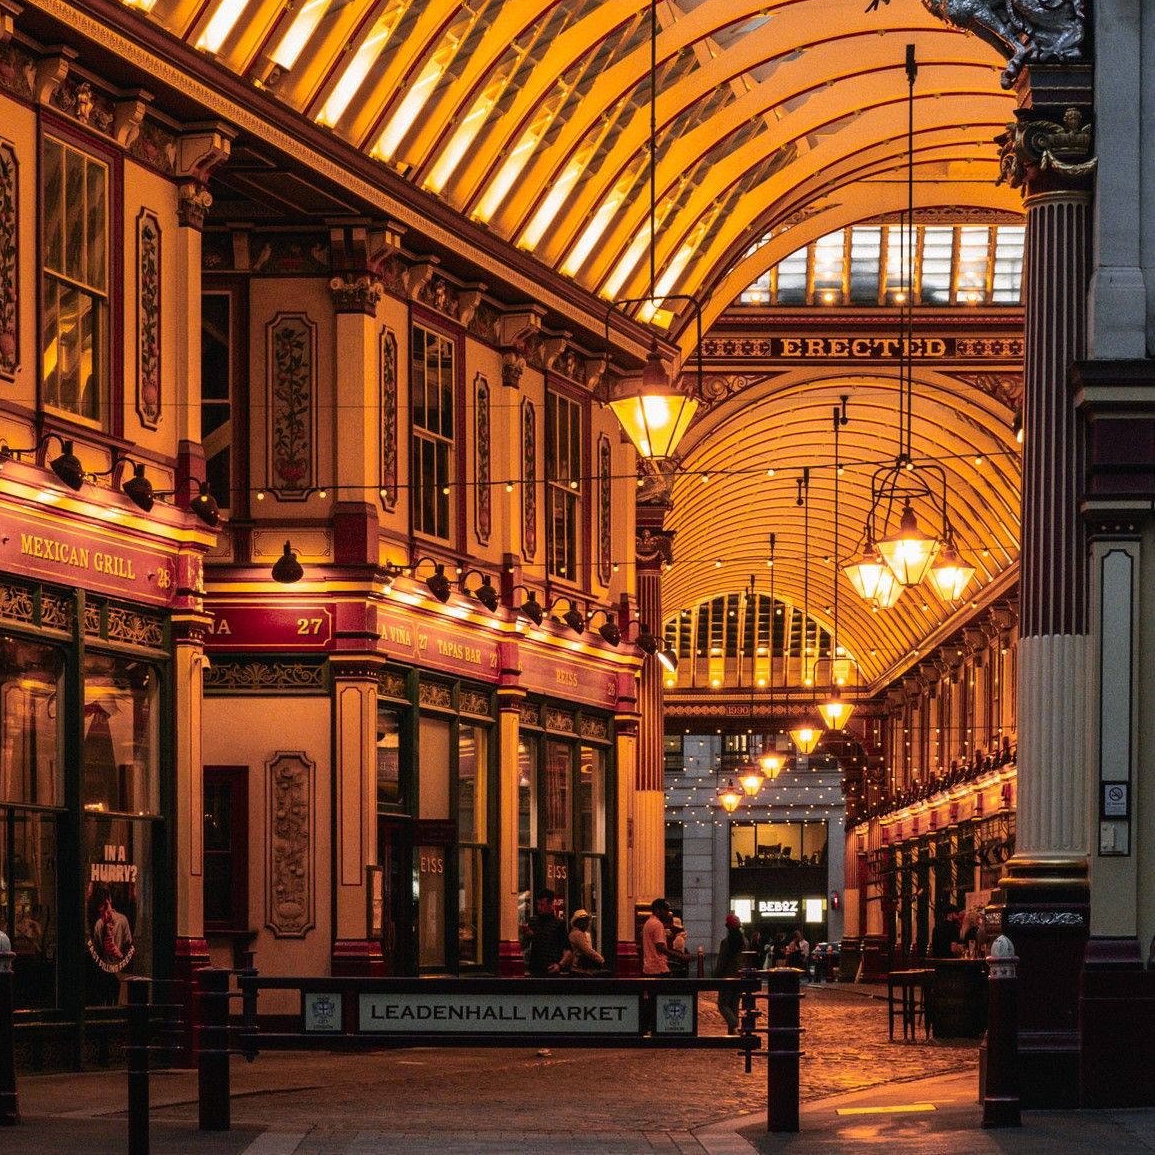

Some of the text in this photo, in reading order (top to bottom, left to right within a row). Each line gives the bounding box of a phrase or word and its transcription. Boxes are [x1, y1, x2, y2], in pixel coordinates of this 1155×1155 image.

[780, 338, 946, 357] ERECTED
[20, 533, 89, 569] MEXICAN
[93, 552, 136, 580] GRILL
[297, 618, 323, 635] 27
[390, 626, 412, 647] VIÑA
[418, 634, 428, 650] 27
[437, 639, 463, 660] TAPAS
[465, 646, 482, 665] BAR
[556, 668, 578, 687] REISS
[104, 845, 126, 861] IN A
[91, 863, 138, 883] HURRY?
[371, 1005, 627, 1021] LEADENHALL MARKET
